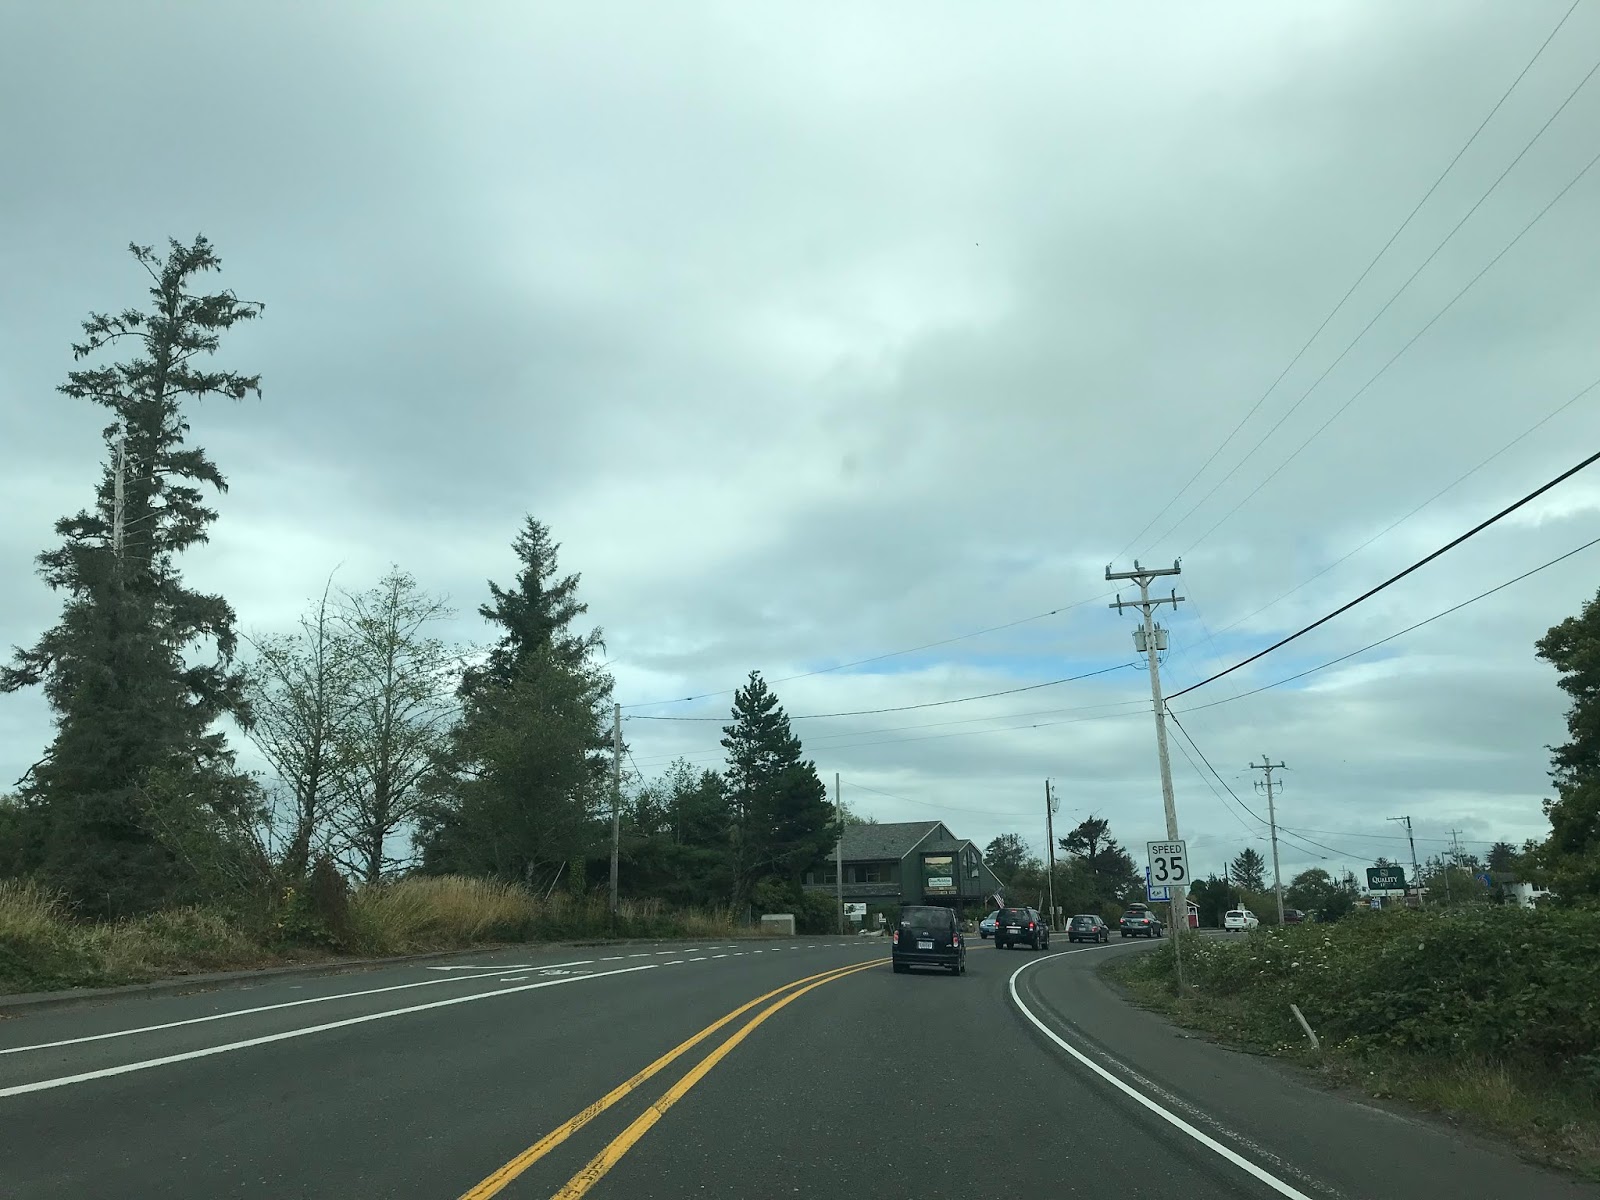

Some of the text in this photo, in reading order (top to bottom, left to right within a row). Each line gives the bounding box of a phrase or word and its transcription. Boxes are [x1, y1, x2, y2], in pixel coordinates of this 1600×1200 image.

[1152, 845, 1182, 855] SPEED
[1154, 856, 1185, 881] 35
[1372, 876, 1398, 884] QUALITY
